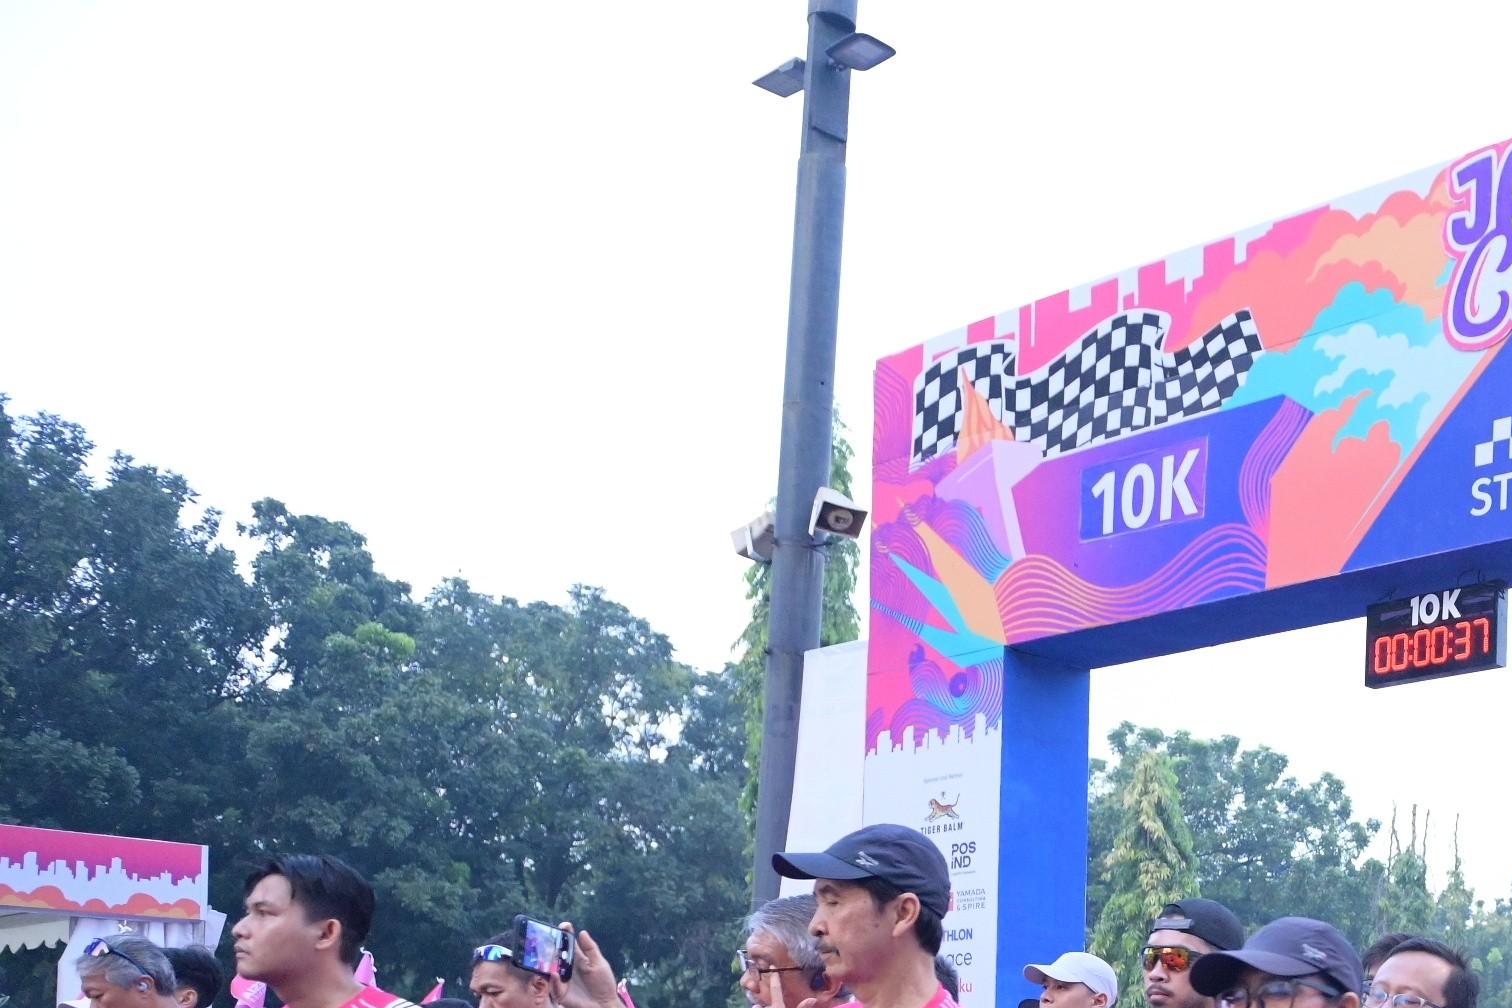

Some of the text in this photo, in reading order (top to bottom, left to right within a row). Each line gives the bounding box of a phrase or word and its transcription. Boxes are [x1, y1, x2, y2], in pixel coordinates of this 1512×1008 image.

[1091, 447, 1202, 536] 10K
[1410, 588, 1462, 627] 10K
[1374, 617, 1491, 674] 00:00:37
[921, 822, 964, 835] TIGER BALM
[951, 841, 976, 856] POS
[956, 888, 986, 897] YAMADA
[962, 902, 986, 911] SPIRE
